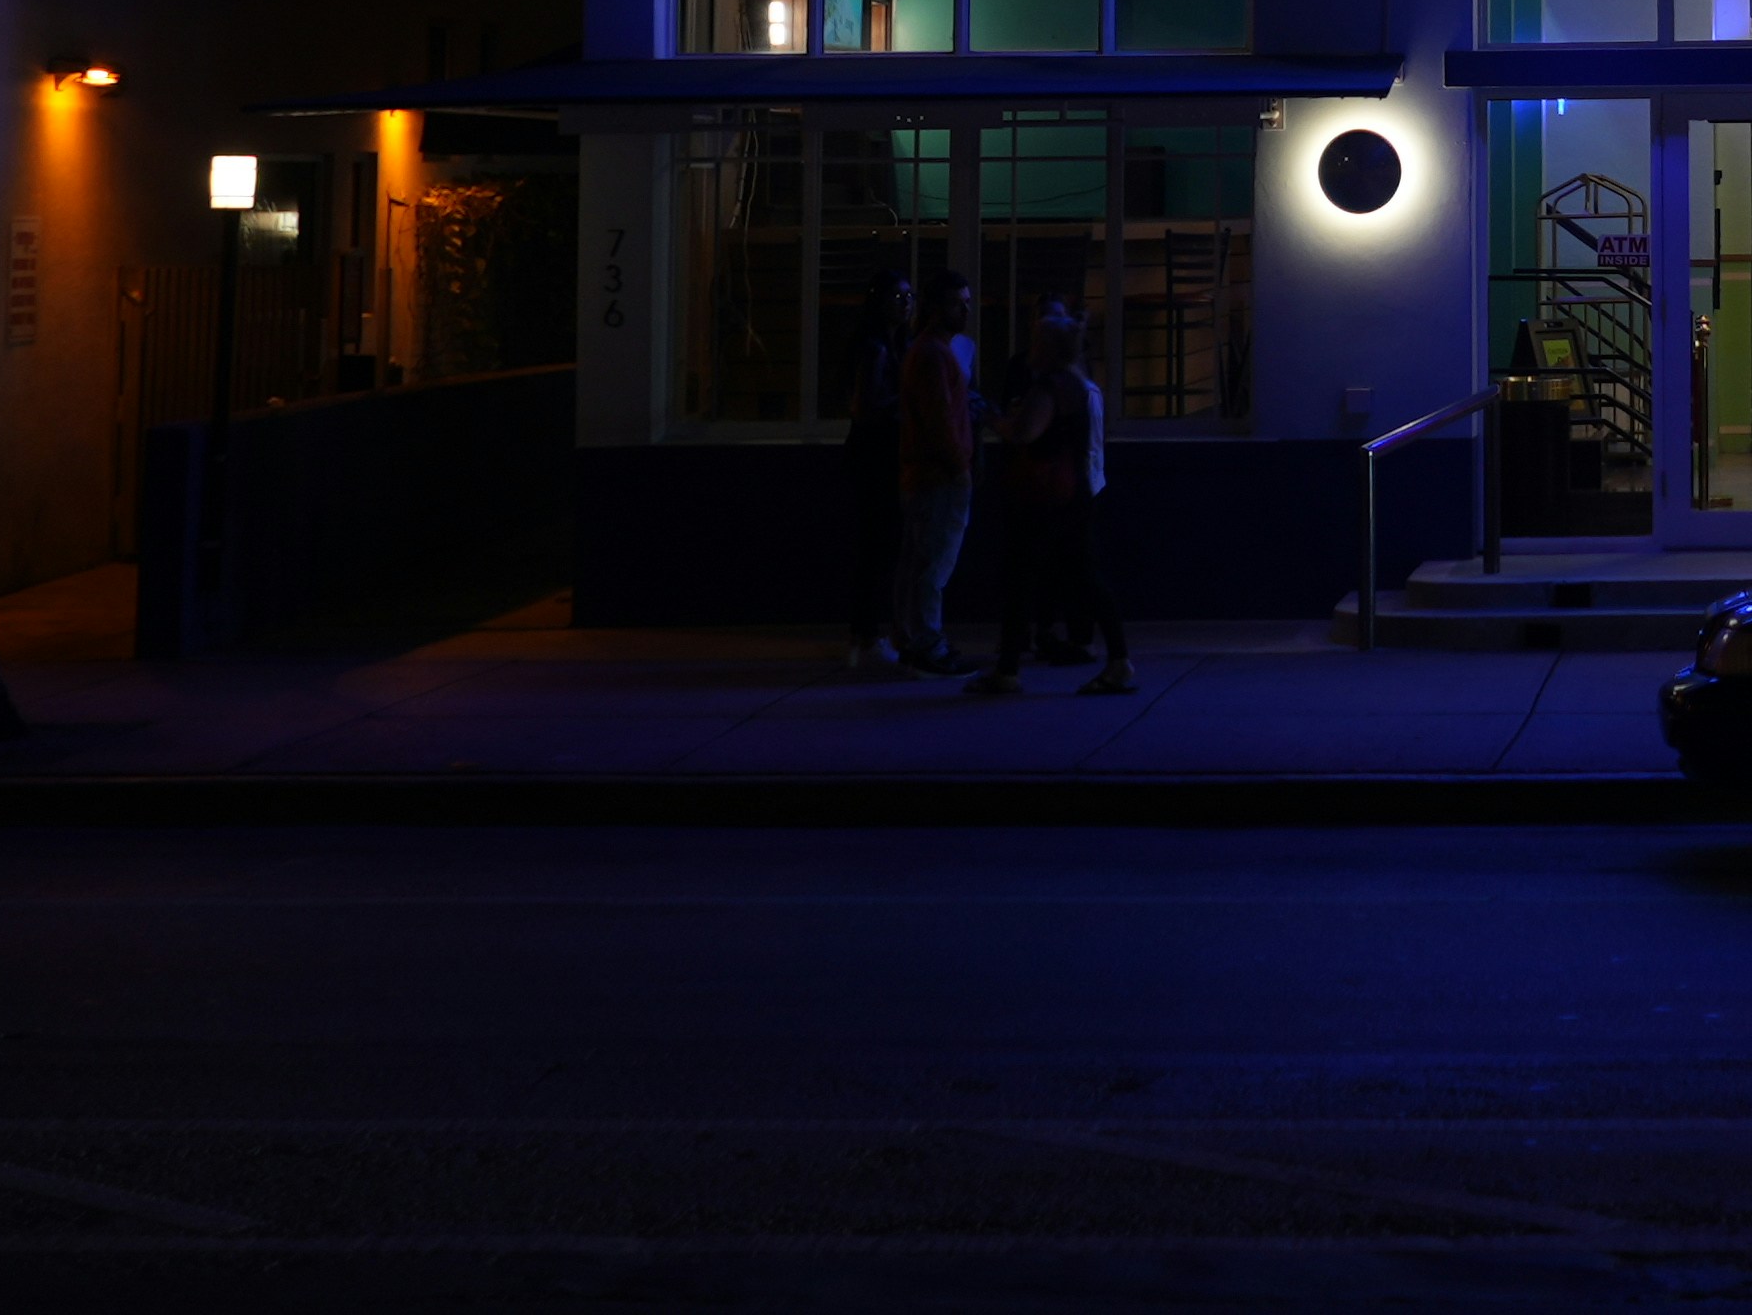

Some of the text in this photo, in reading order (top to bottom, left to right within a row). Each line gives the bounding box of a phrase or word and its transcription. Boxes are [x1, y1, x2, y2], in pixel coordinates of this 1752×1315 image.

[1600, 236, 1647, 252] ATM
[1599, 256, 1647, 265] INSIDE
[604, 229, 625, 327] 736
